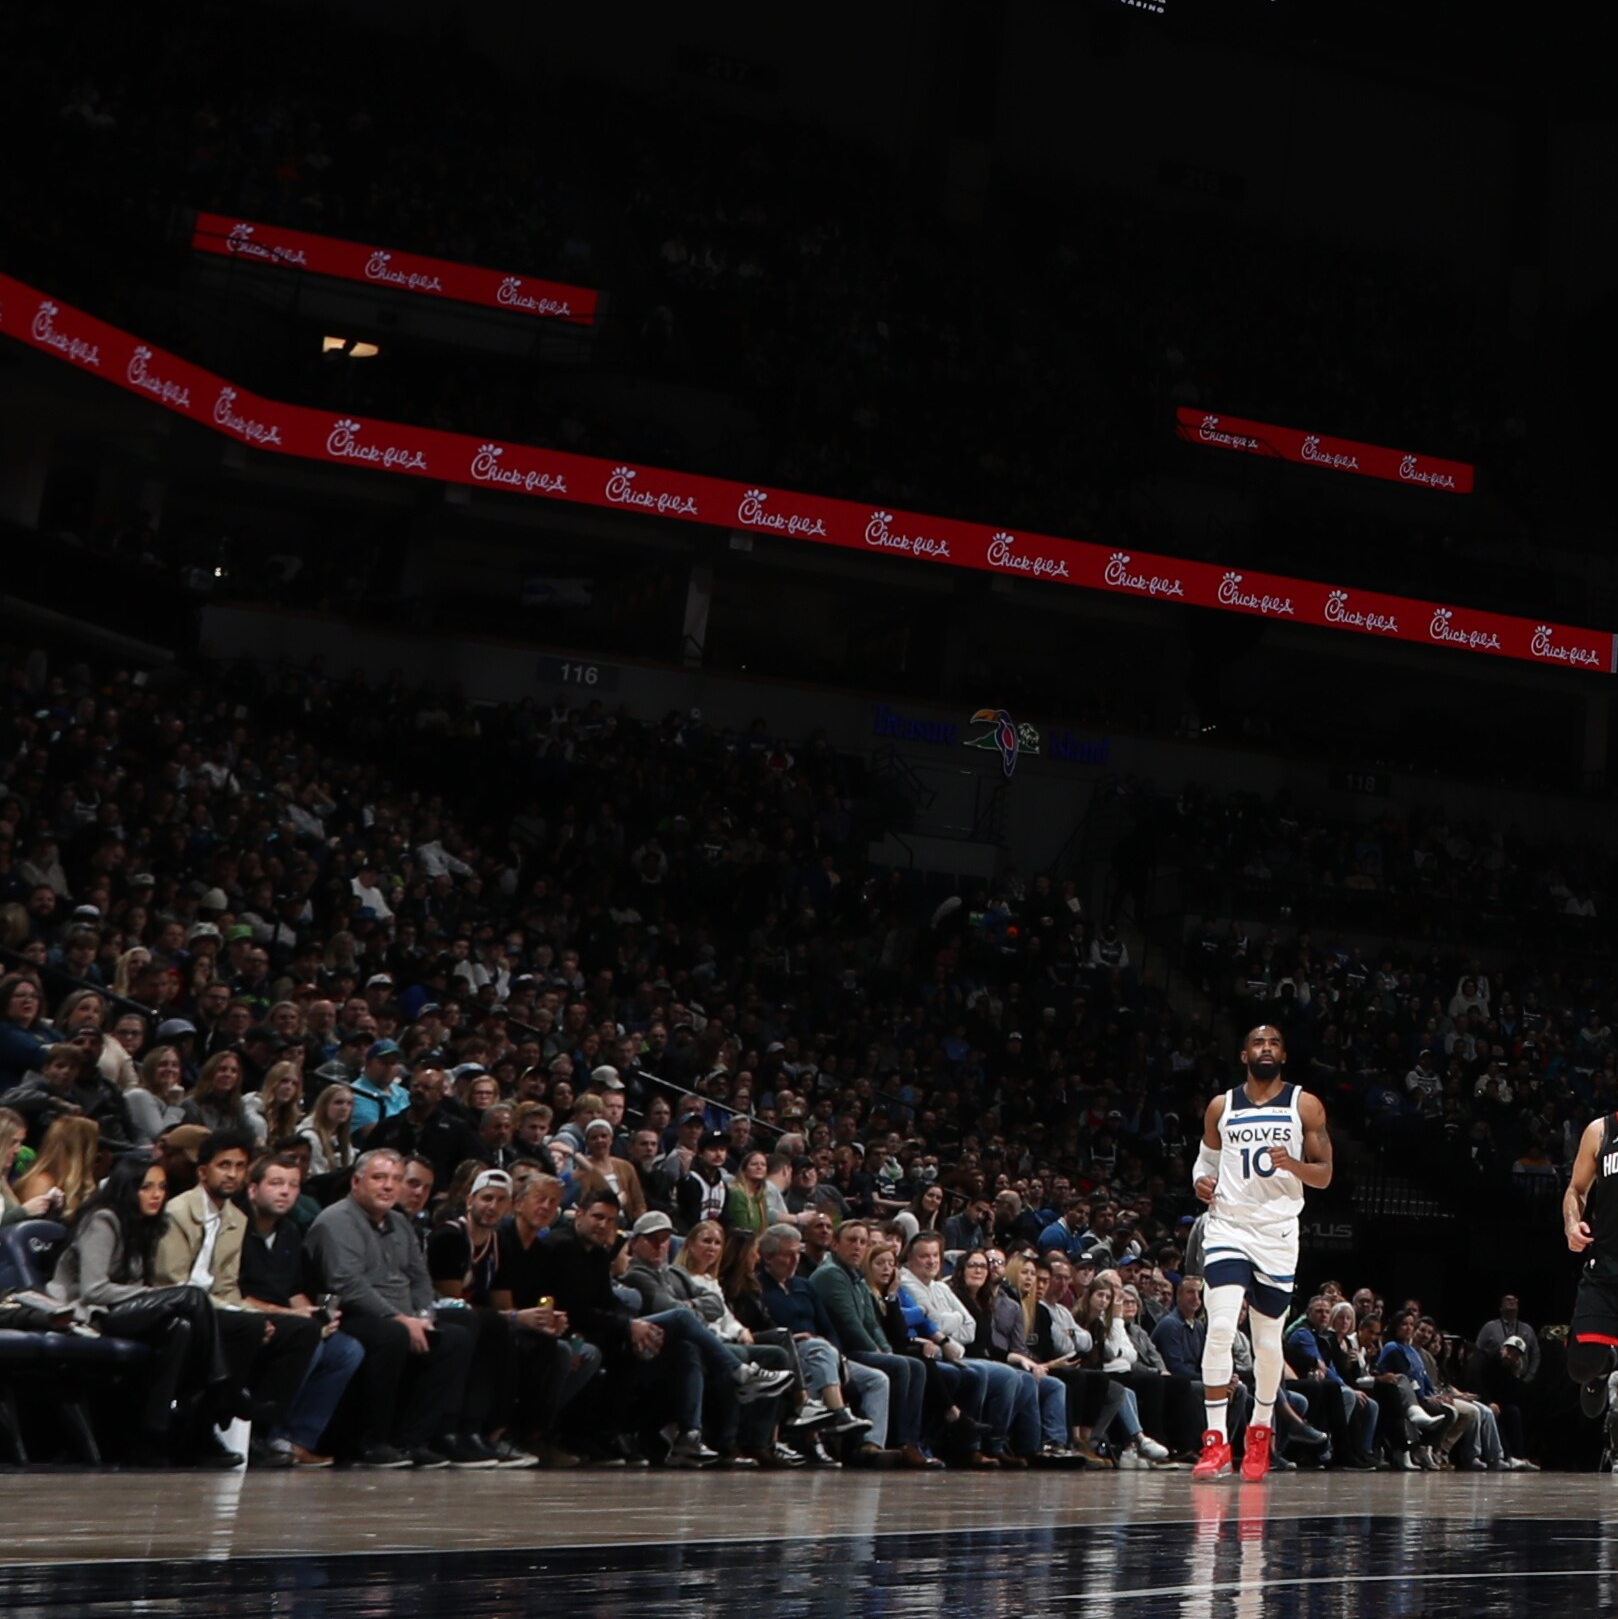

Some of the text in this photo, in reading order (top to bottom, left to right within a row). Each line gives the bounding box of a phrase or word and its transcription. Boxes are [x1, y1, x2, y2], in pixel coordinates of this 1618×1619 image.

[560, 662, 599, 684] 116
[872, 703, 957, 747] Treasure
[1226, 1127, 1290, 1143] WOLVES
[1238, 1146, 1275, 1179] 10
